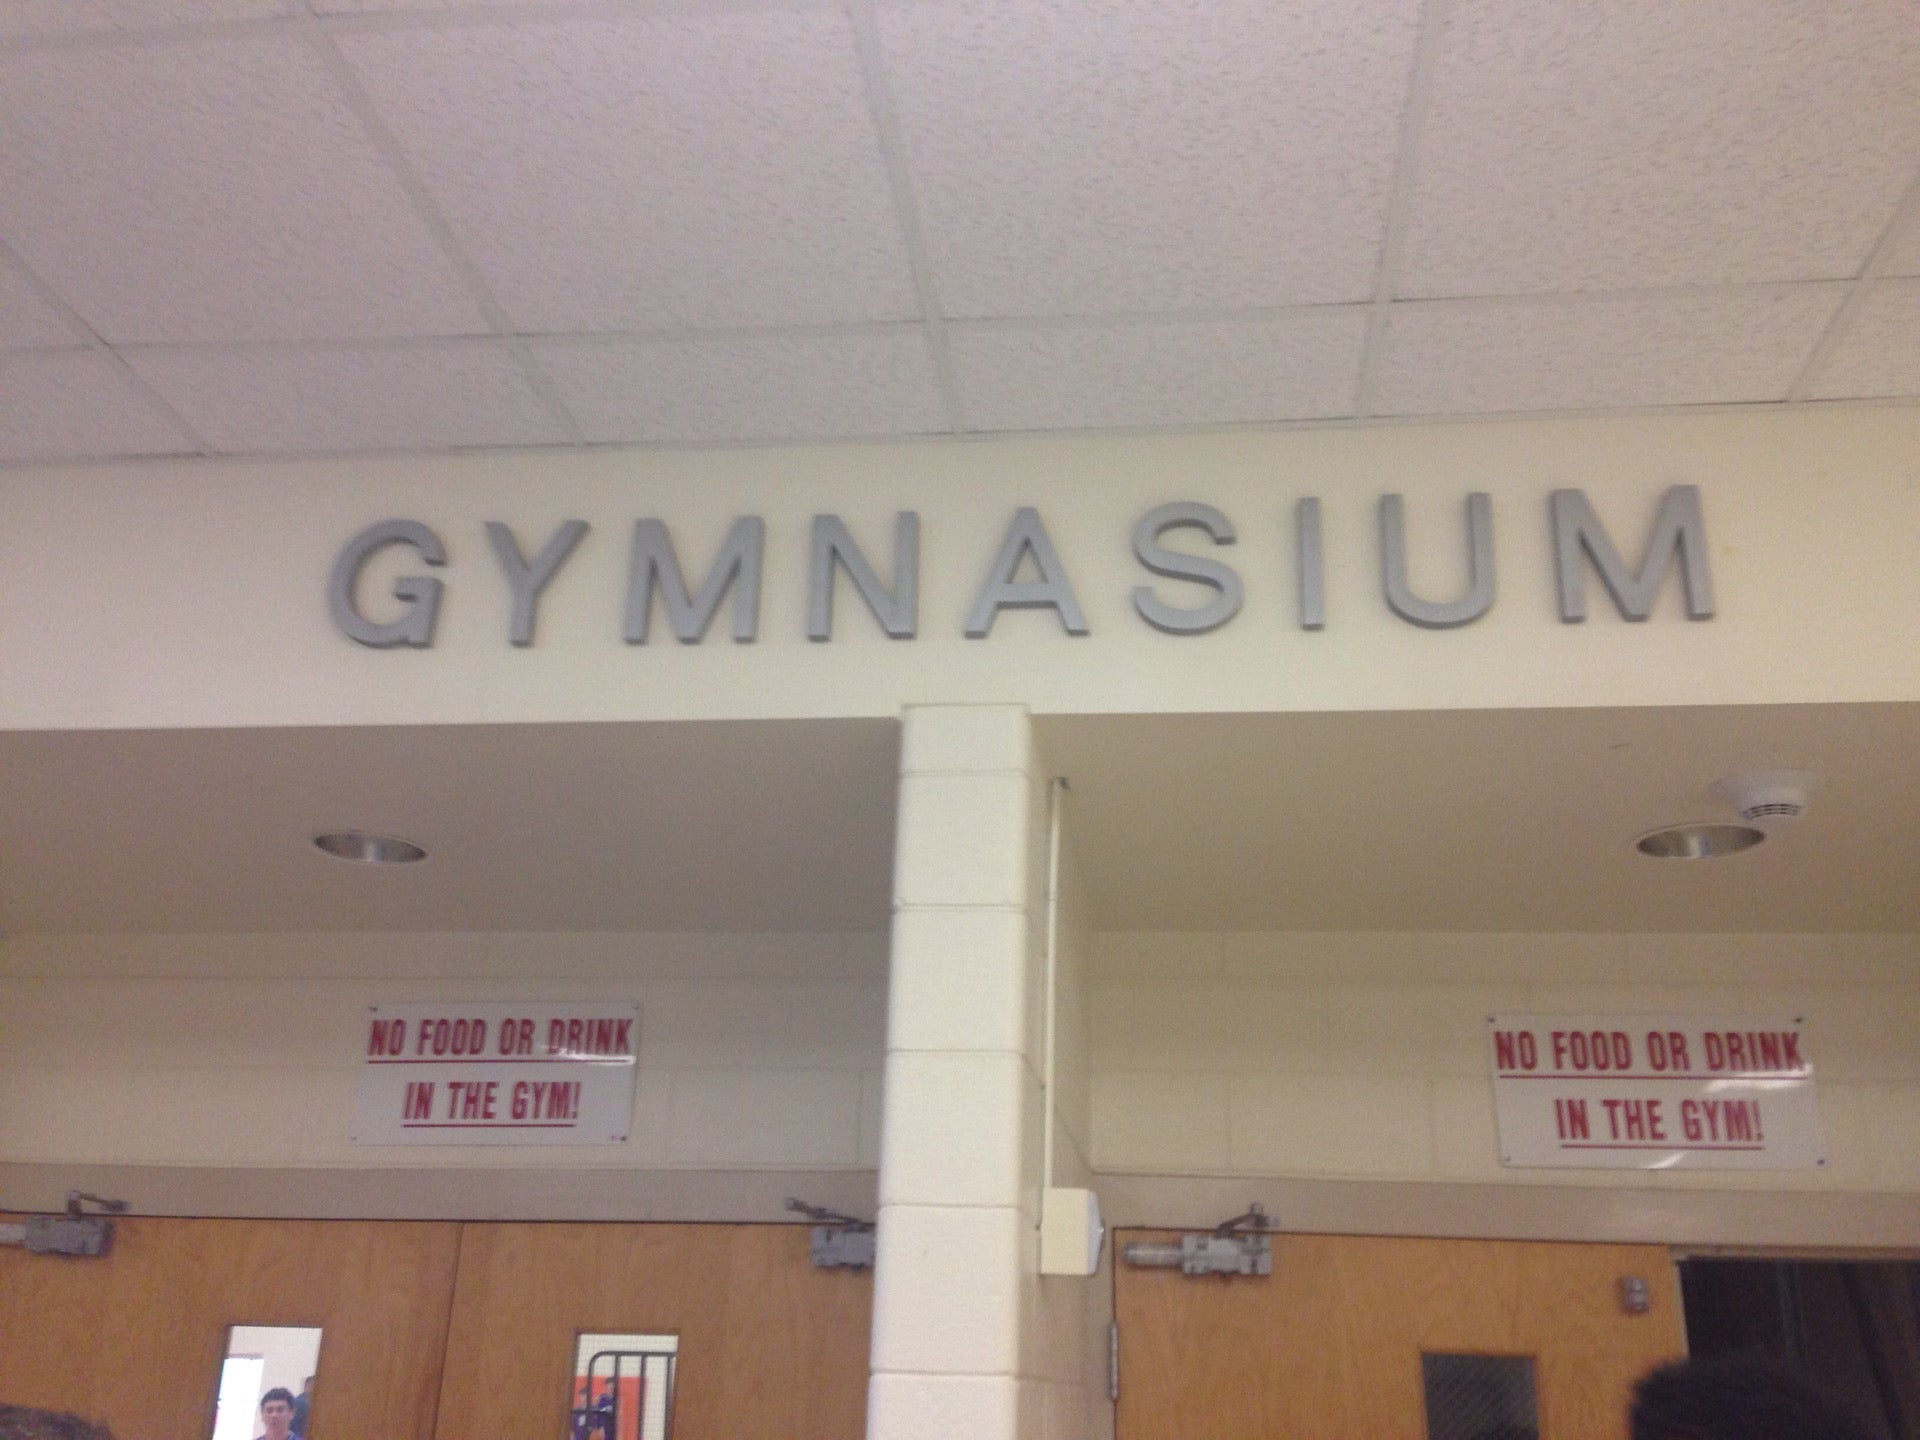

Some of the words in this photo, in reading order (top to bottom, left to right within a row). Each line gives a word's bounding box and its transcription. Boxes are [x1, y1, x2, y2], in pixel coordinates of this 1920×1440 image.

[327, 485, 1717, 649] GYMNASIUM
[367, 1018, 406, 1055] NO
[416, 1018, 486, 1055] FOOD
[499, 1018, 535, 1055] OR
[547, 1018, 633, 1056] DRINK
[1494, 1030, 1537, 1071] NO
[1552, 1031, 1632, 1071] FOOD
[1647, 1031, 1691, 1072] OR
[1704, 1031, 1804, 1072] DRINK
[404, 1081, 435, 1120] IN
[447, 1081, 498, 1120] THE
[511, 1080, 581, 1120] GYM!
[1555, 1099, 1590, 1140] IN
[1602, 1099, 1667, 1141] THE
[1680, 1099, 1764, 1142] GYM!
